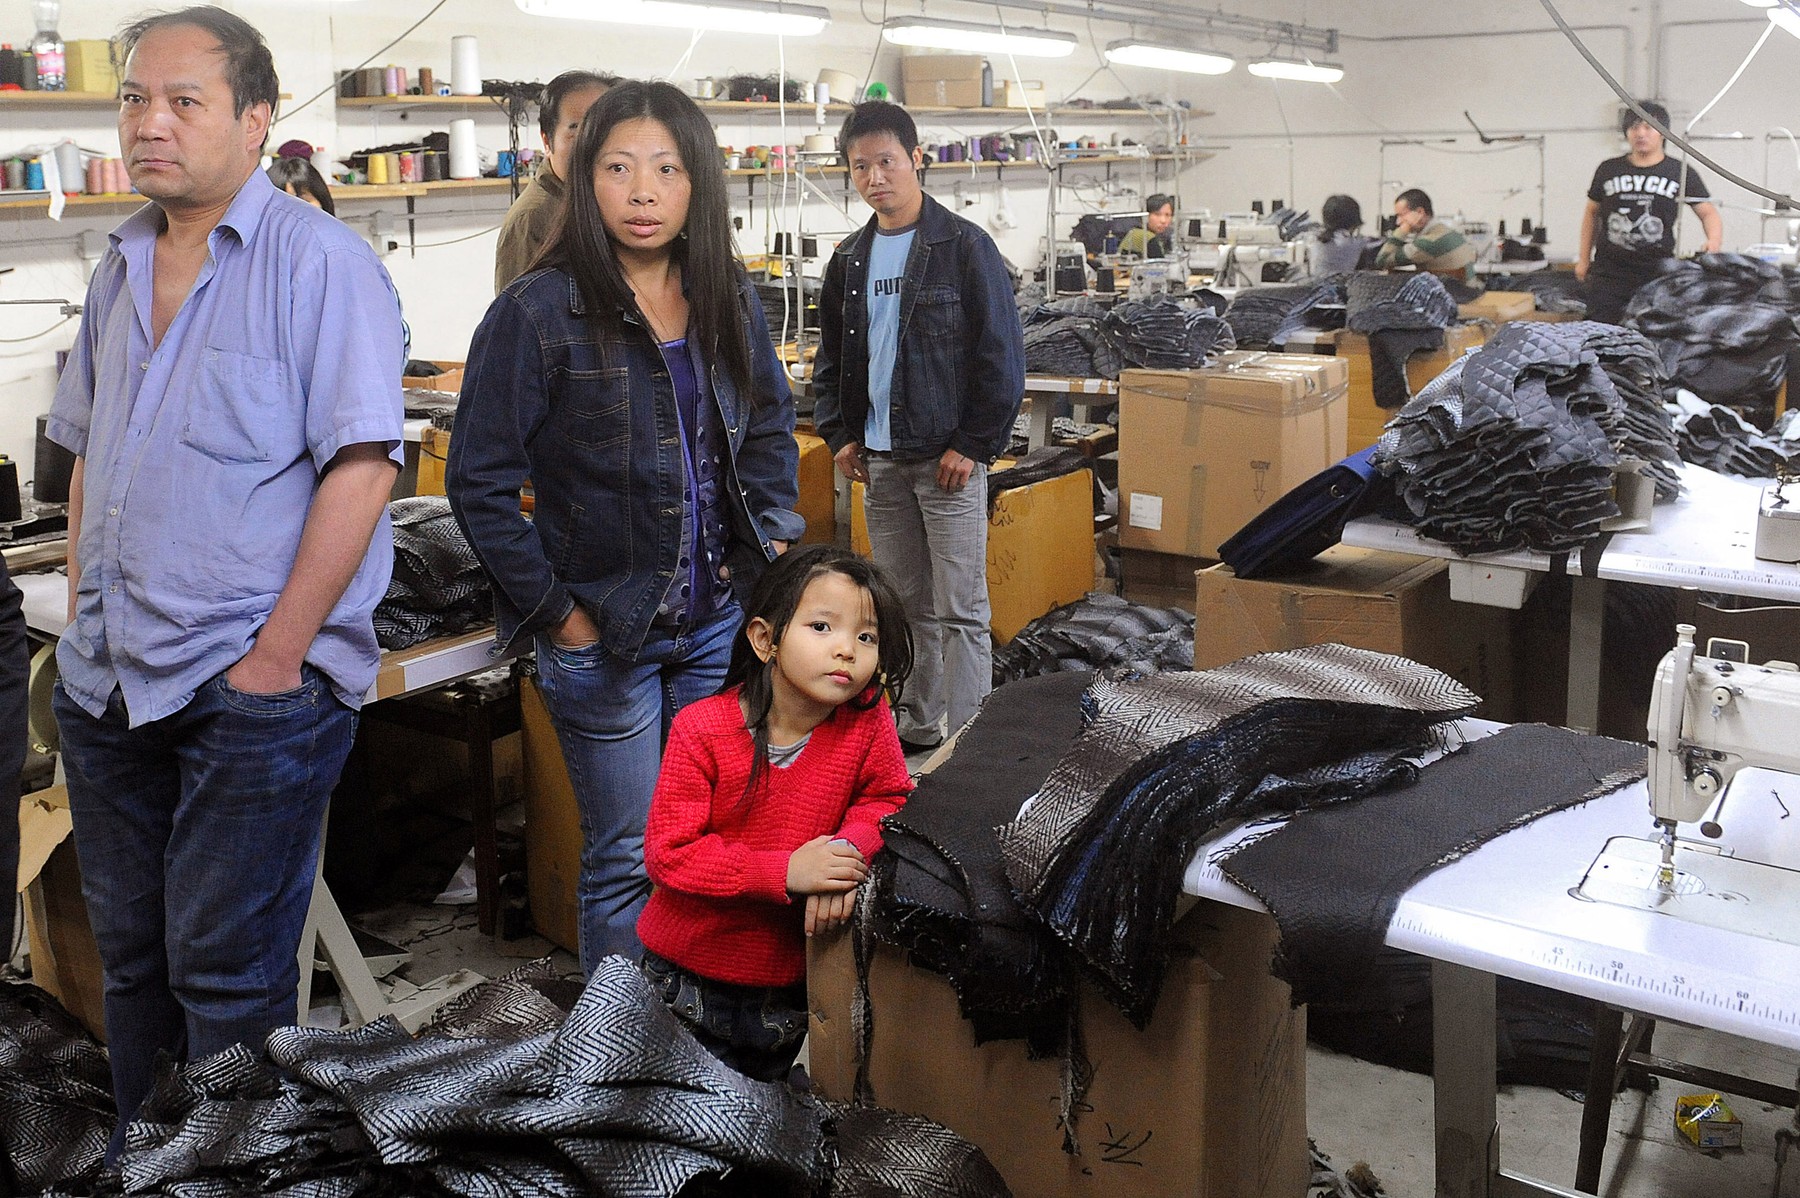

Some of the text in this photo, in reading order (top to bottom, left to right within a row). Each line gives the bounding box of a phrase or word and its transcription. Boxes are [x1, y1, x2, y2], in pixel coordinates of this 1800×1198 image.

[1603, 174, 1680, 199] BICYCLE
[1611, 960, 1624, 970] 50
[1672, 975, 1686, 985] 55
[1736, 990, 1750, 1000] 60
